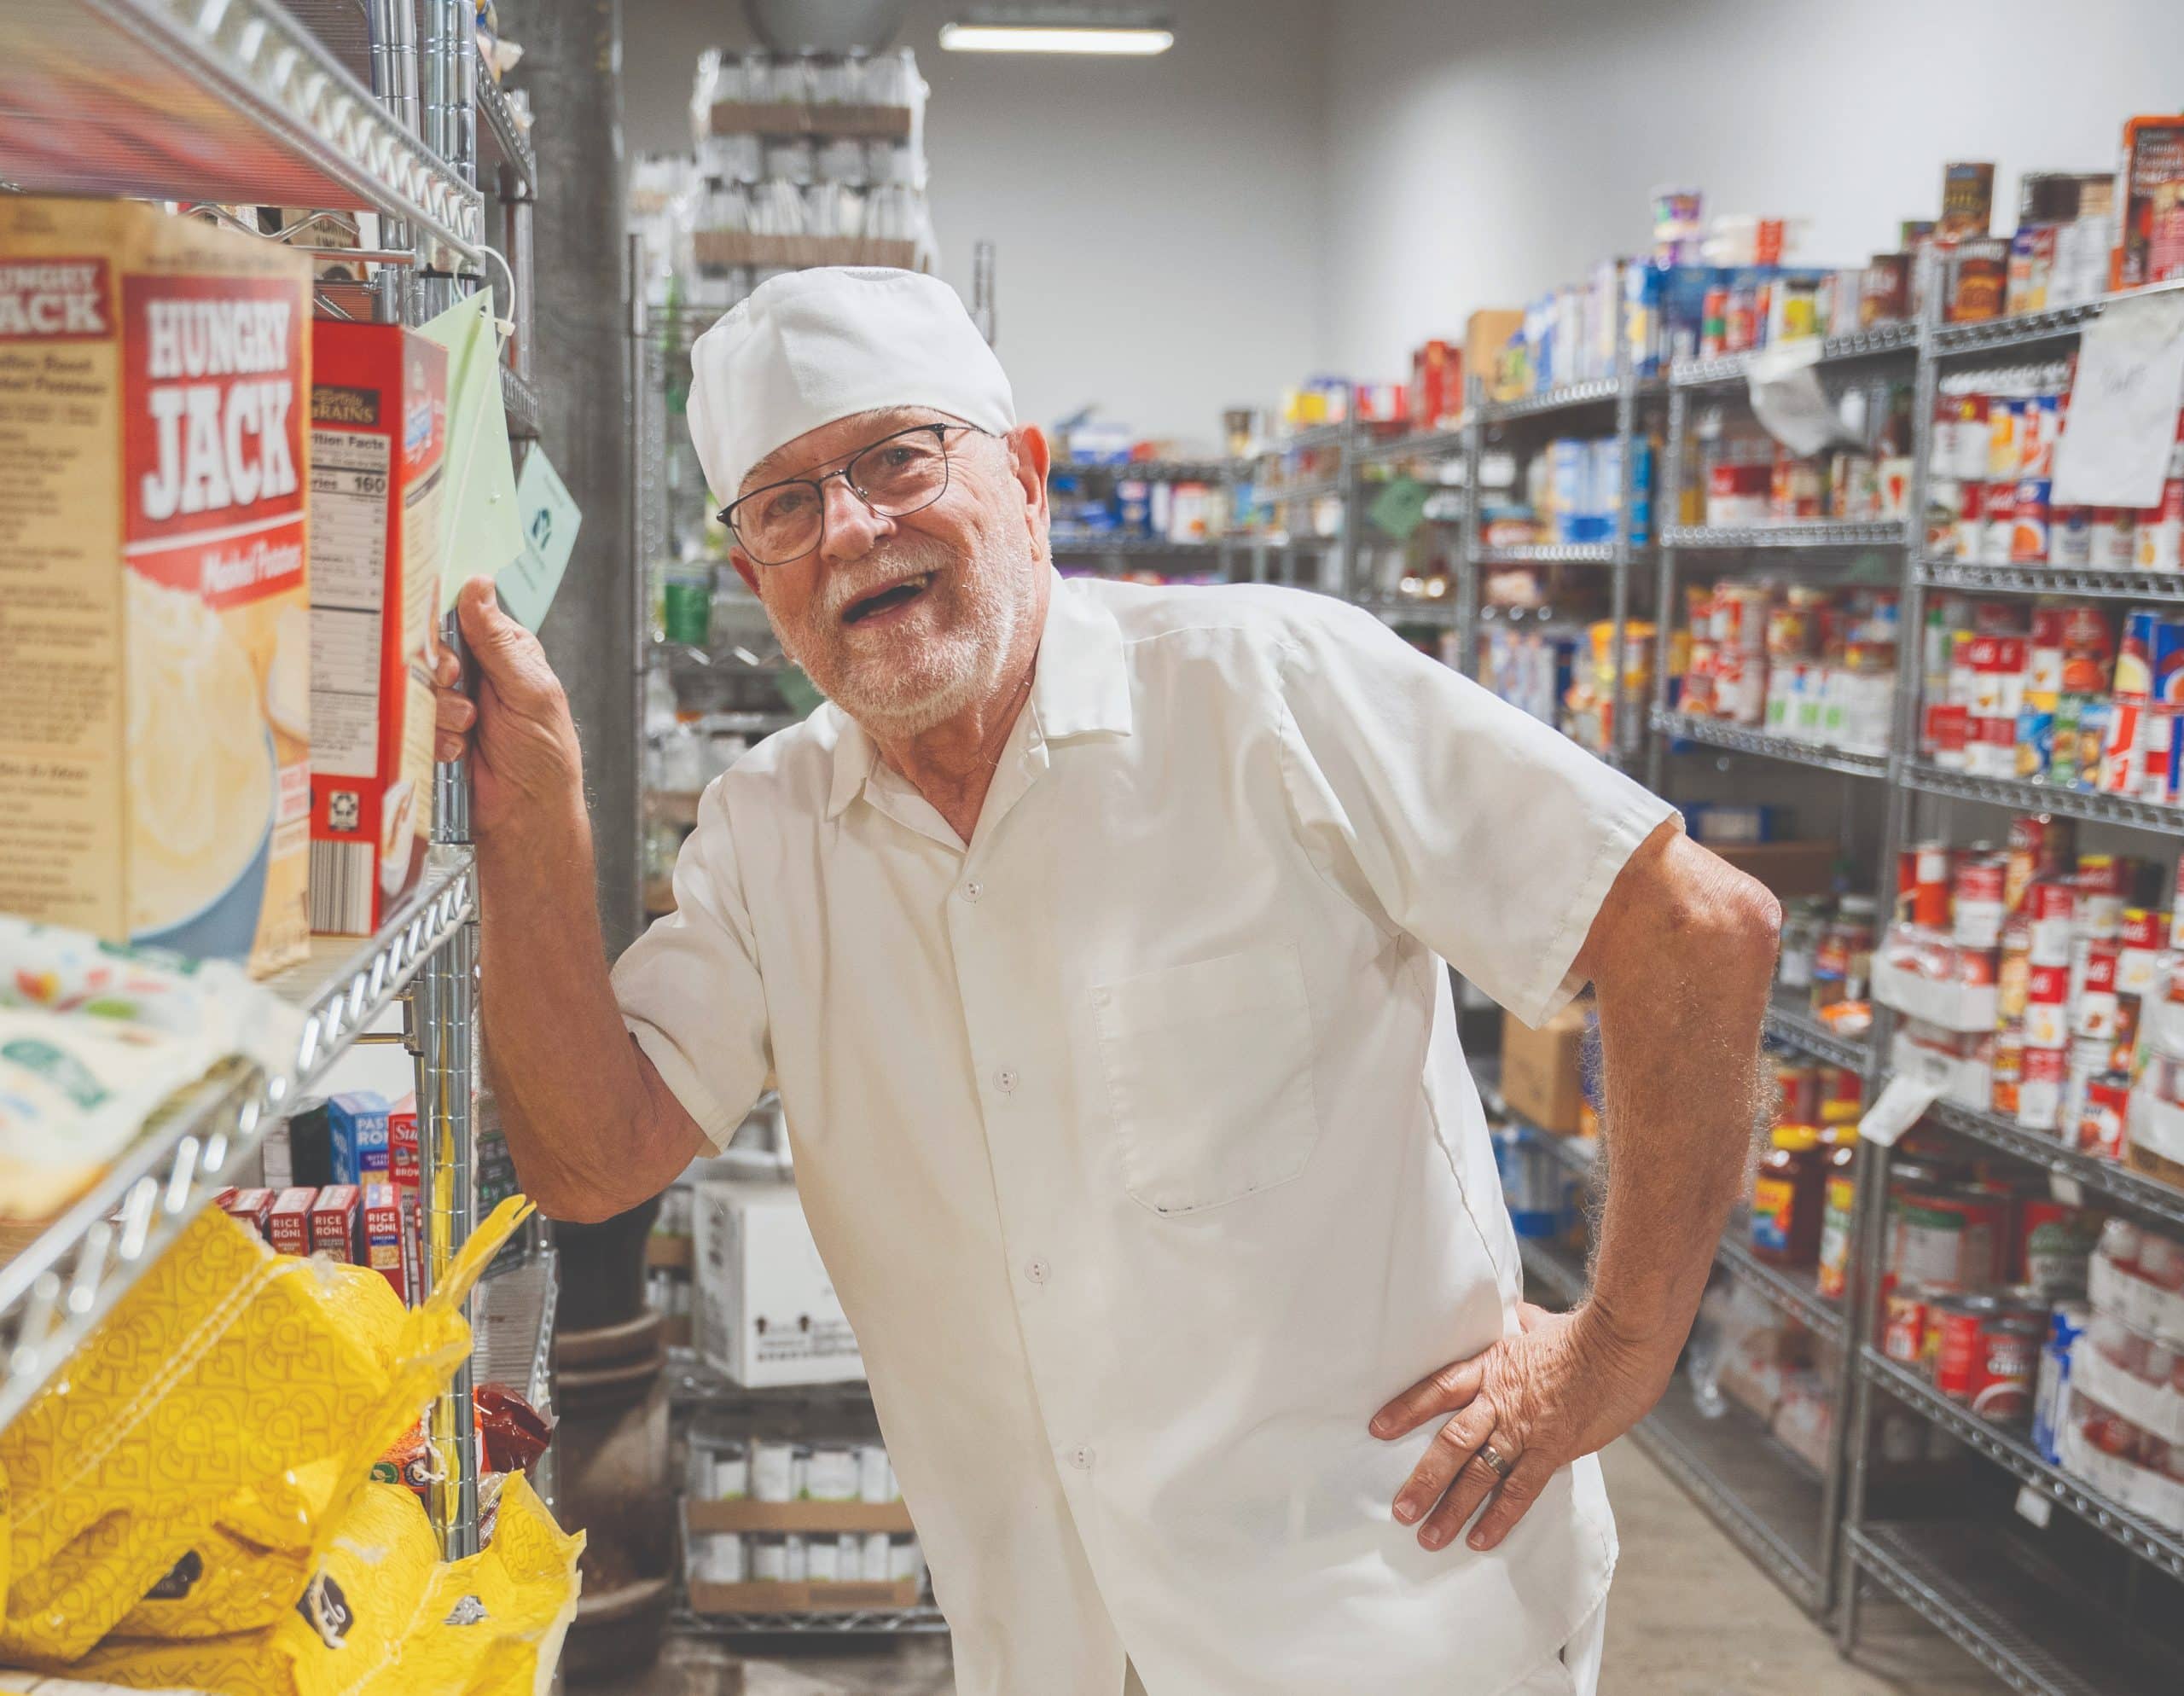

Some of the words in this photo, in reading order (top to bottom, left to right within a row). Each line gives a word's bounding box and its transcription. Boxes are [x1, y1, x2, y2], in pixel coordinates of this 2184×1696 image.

[148, 300, 290, 377] HUNGRY
[312, 433, 342, 446] ition
[349, 436, 384, 450] Facts
[143, 381, 296, 520] JACK
[355, 476, 386, 493] 160
[273, 1218, 300, 1228] RICE
[315, 1216, 341, 1226] RICE
[368, 1213, 396, 1223] RICE
[274, 1229, 300, 1239] RONI
[317, 1227, 343, 1235] RONI
[369, 1224, 396, 1234] RONI
